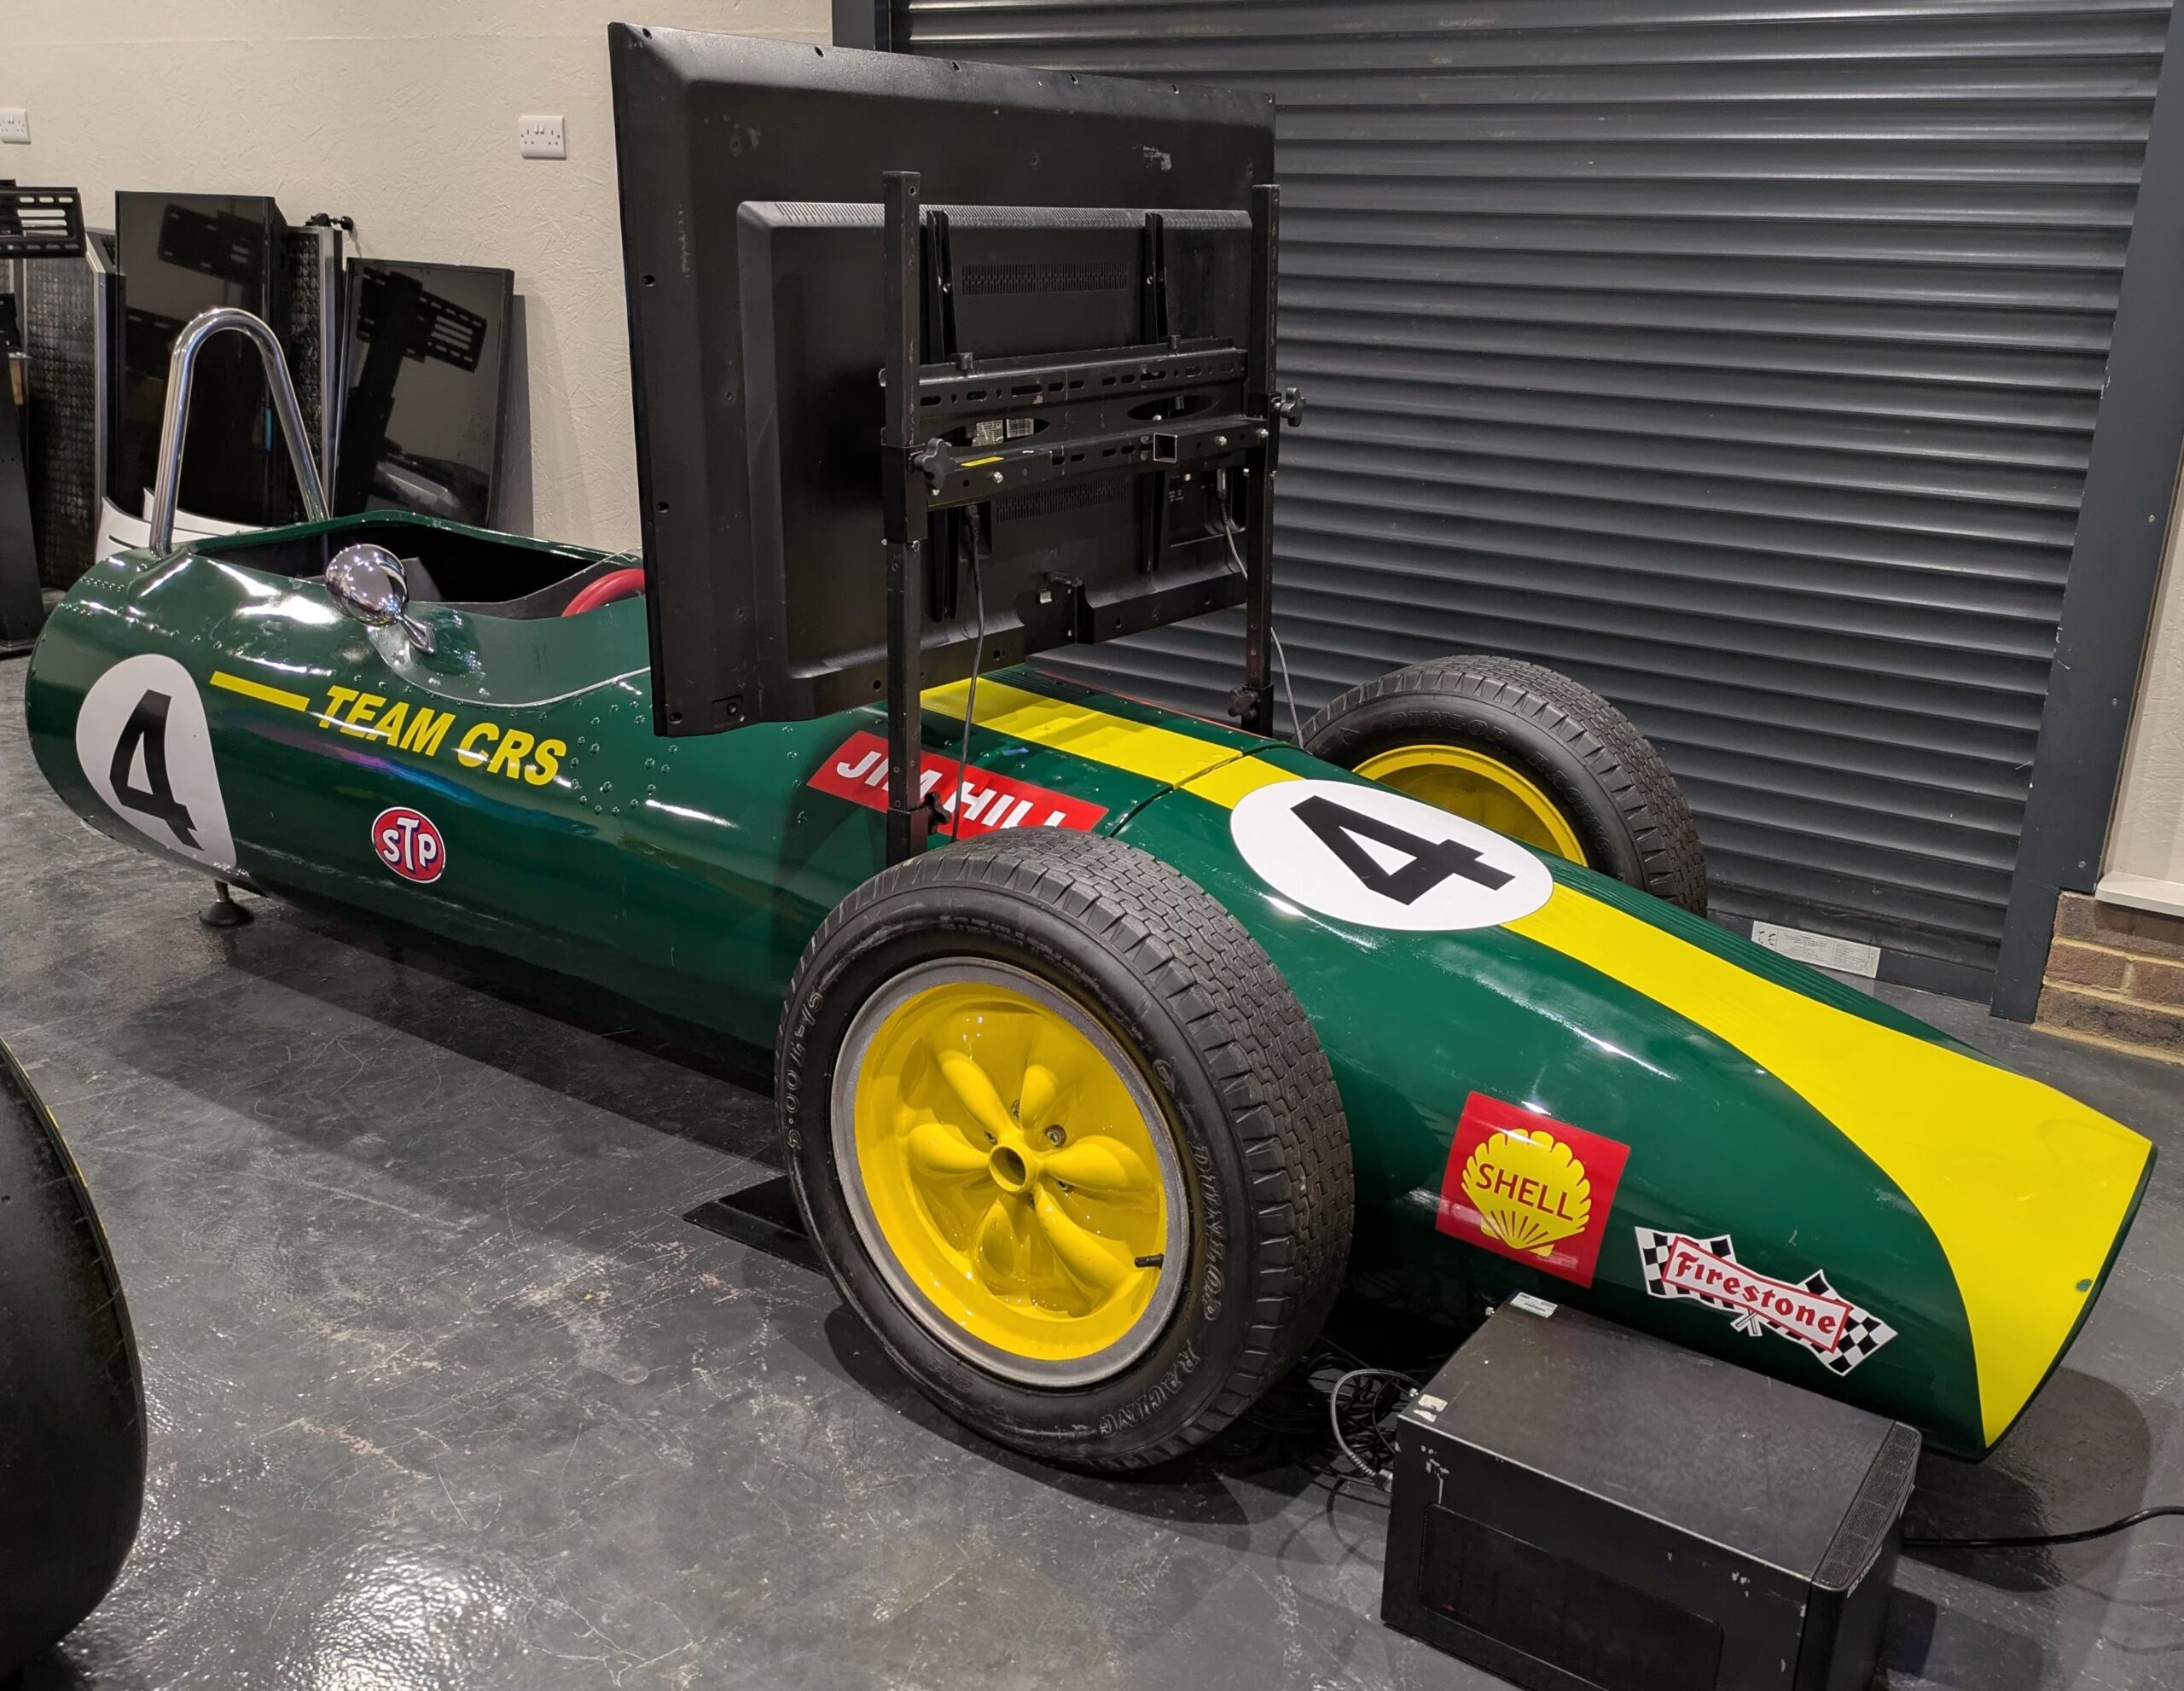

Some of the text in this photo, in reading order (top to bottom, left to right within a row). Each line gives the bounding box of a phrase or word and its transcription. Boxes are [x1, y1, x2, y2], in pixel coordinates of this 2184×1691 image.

[108, 689, 203, 851] 4
[317, 685, 566, 786] TEAM CRS
[1388, 711, 1508, 743] DUNLOP
[382, 816, 438, 871] STP
[1290, 794, 1515, 906] 4
[1528, 752, 1616, 854] RACING
[1191, 1144, 1224, 1322] DUNLOP
[1474, 1163, 1573, 1222] SHELL
[1674, 1249, 1838, 1335] Firestone
[1099, 1339, 1201, 1438] RACING
